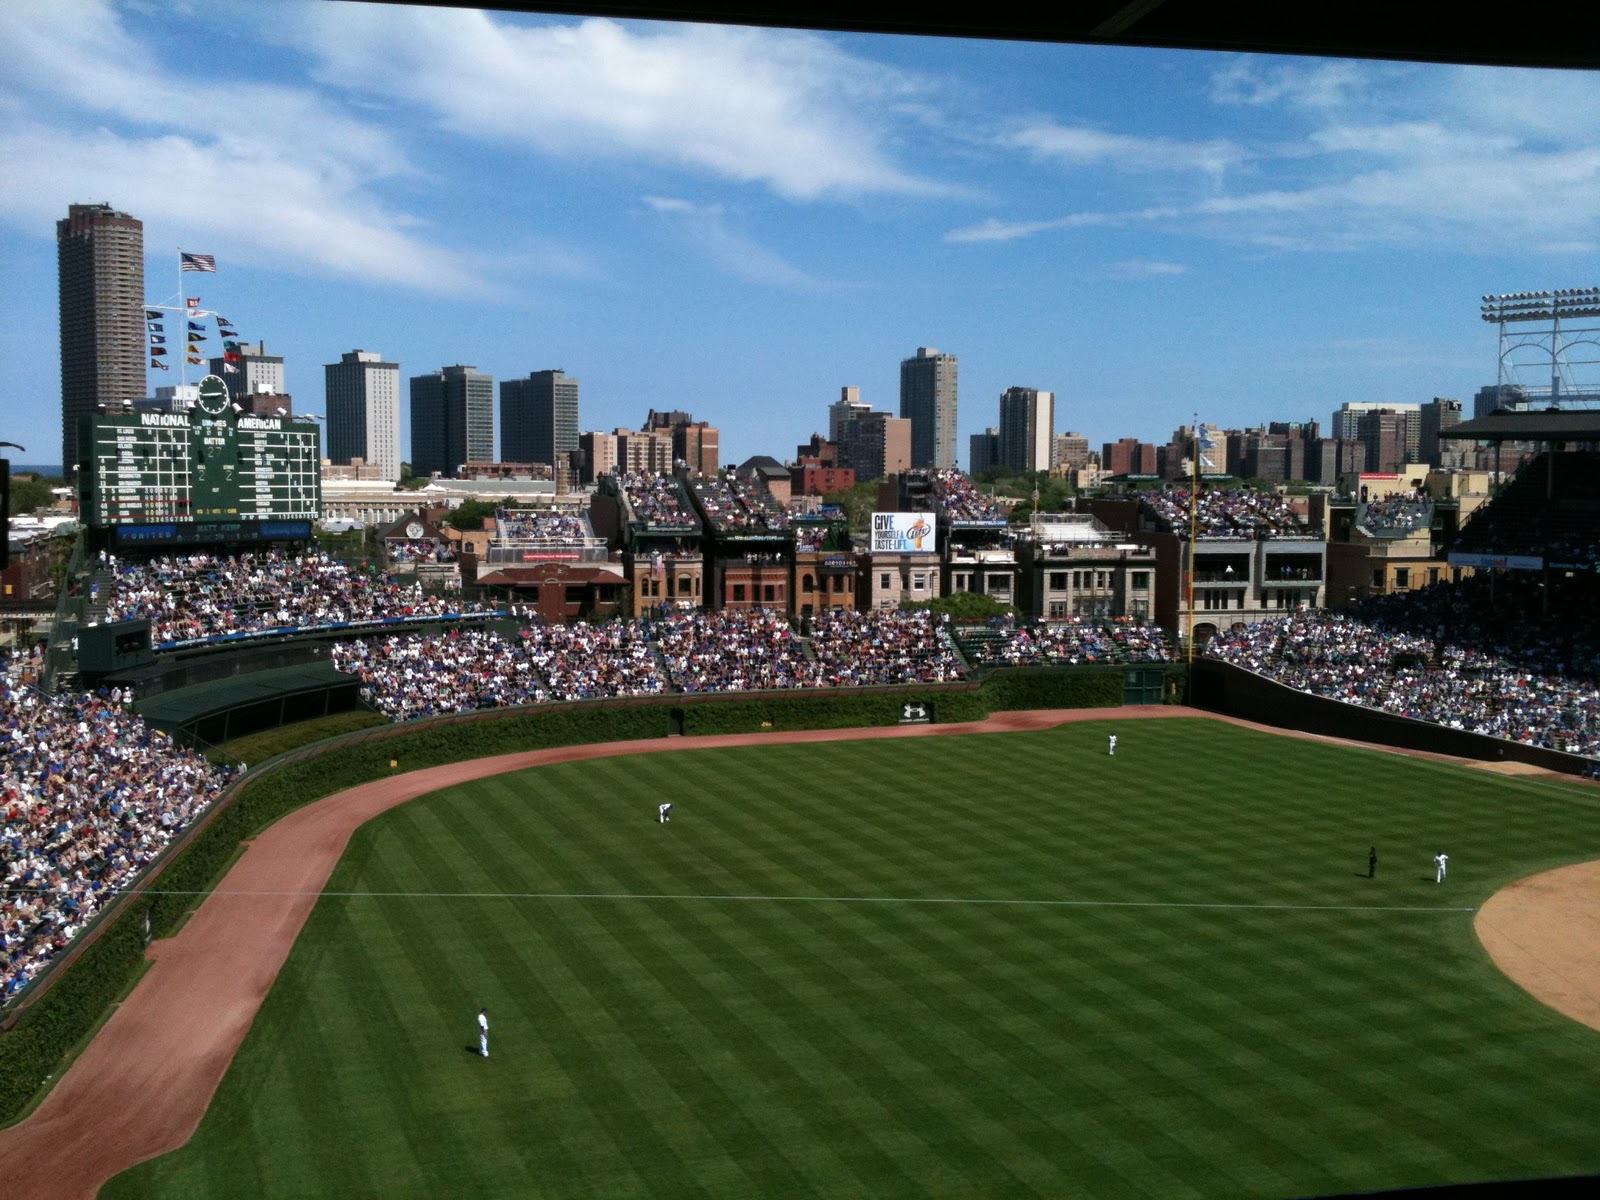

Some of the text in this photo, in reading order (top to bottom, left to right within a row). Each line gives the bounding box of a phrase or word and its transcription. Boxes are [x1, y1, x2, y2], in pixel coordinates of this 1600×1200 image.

[142, 414, 190, 426] NATIONAL
[238, 418, 280, 430] AMERICAN
[874, 515, 894, 530] GIVE
[875, 531, 900, 539] YOURSELF
[875, 540, 907, 549] TASTE-LIFT
